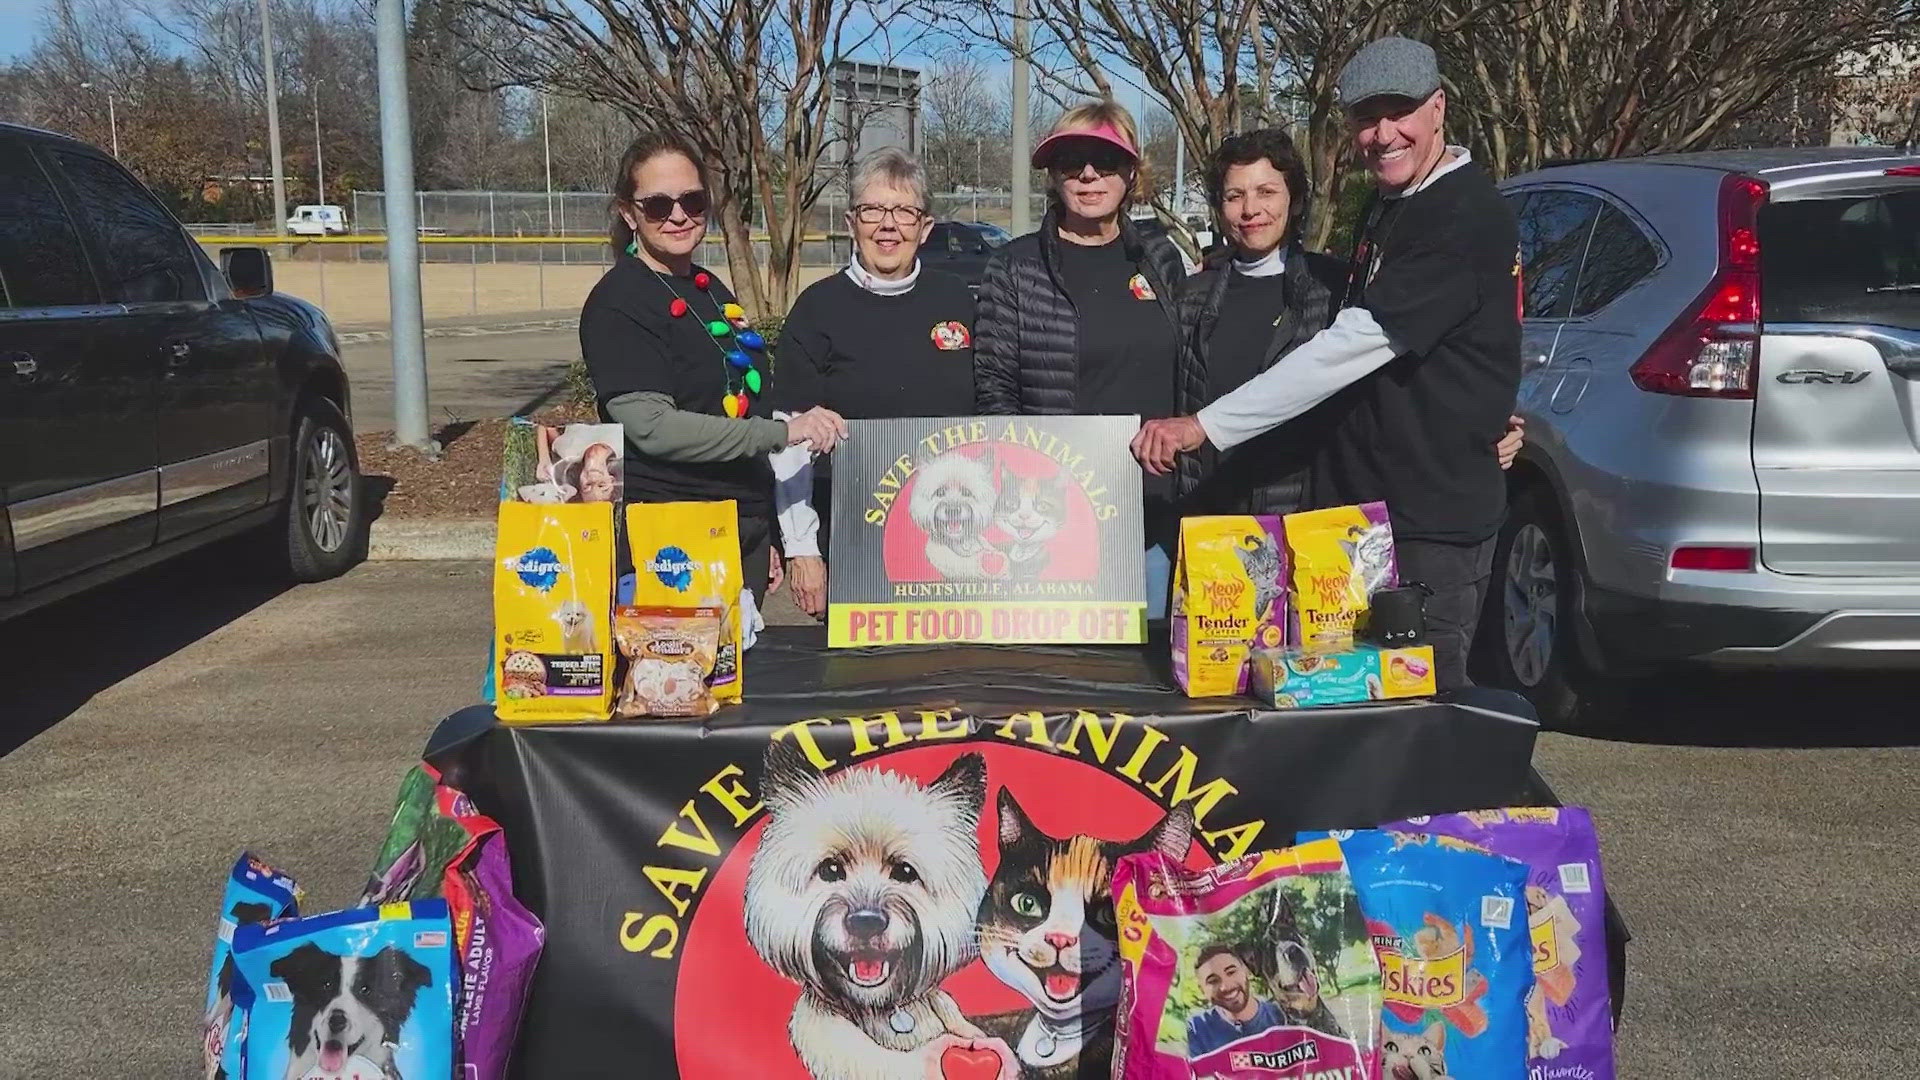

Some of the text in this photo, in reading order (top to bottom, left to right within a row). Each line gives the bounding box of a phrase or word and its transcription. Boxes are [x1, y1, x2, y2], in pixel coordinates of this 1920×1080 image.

[864, 421, 1118, 527] SAVE THE ANIMALS
[504, 559, 571, 576] Pedigree
[645, 559, 704, 576] Pedigree
[1015, 582, 1094, 595] ALABAMA
[849, 608, 1130, 642] PET FOOD DROP OFF
[1195, 613, 1249, 629] Tender
[1305, 607, 1362, 624] Tender
[618, 707, 1268, 960] SAVE THE ANIMA
[468, 916, 486, 969] ADULT
[471, 947, 493, 1026] LAMB FLAVOR
[1381, 962, 1455, 998] iskies
[1253, 1044, 1315, 1067] PURINA
